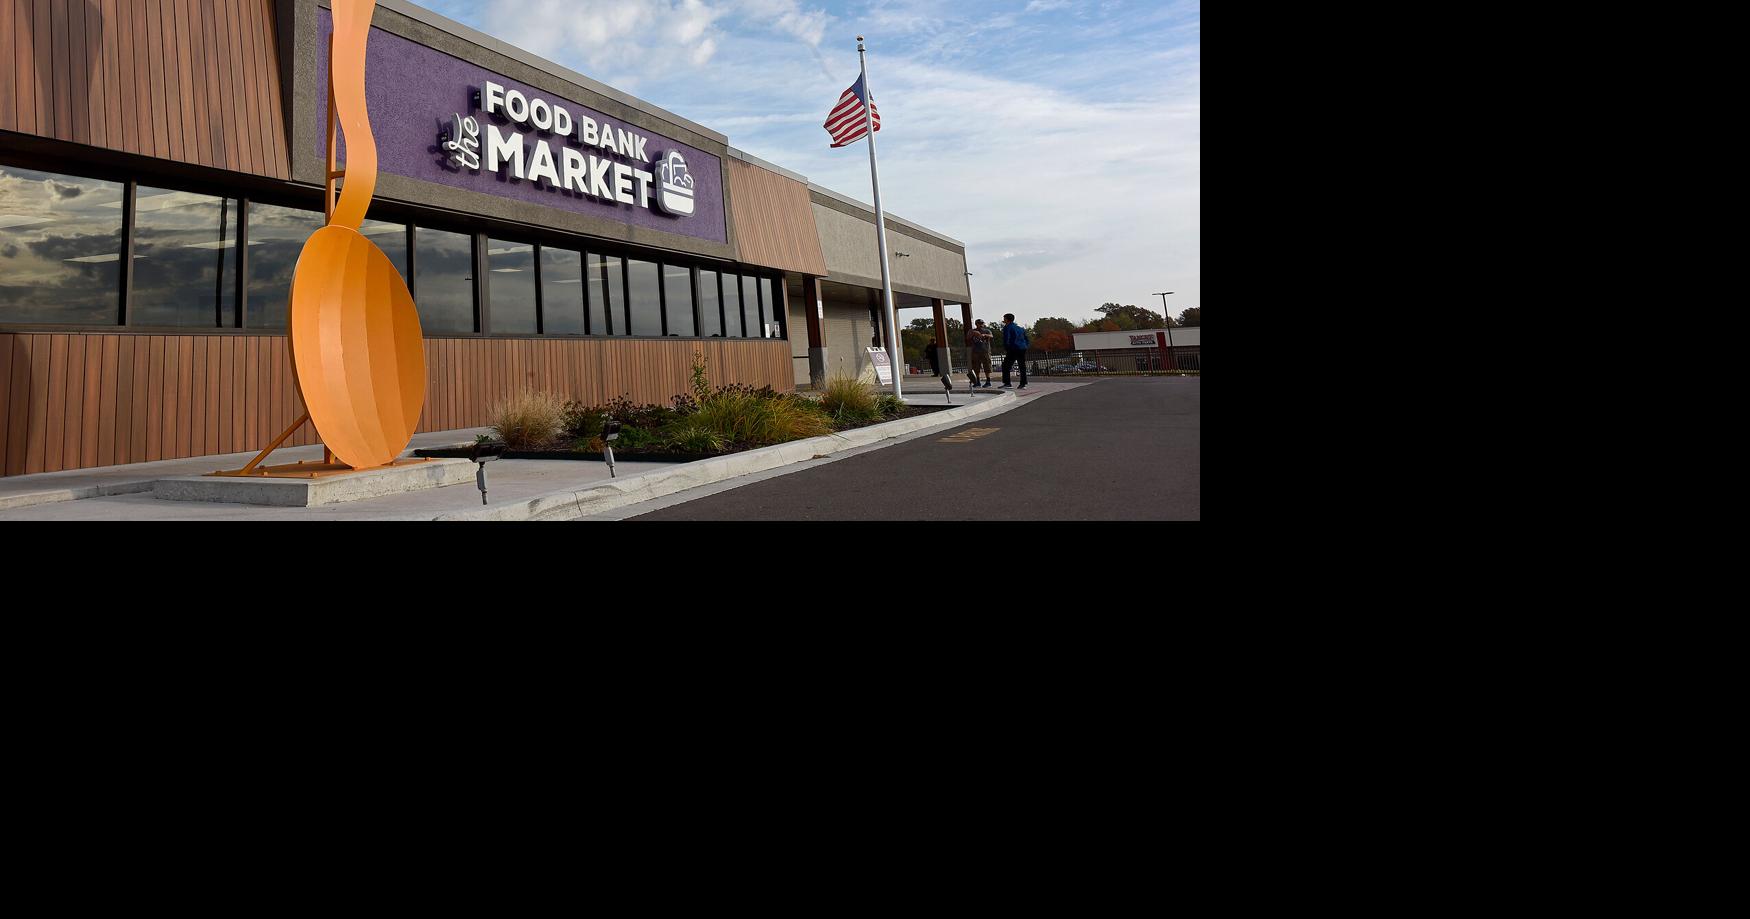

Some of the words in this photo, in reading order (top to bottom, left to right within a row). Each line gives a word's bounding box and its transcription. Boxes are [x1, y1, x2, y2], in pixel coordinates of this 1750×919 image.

[447, 113, 480, 170] the
[485, 80, 573, 137] FOOD
[581, 115, 650, 163] BANK
[486, 123, 653, 209] MARKET
